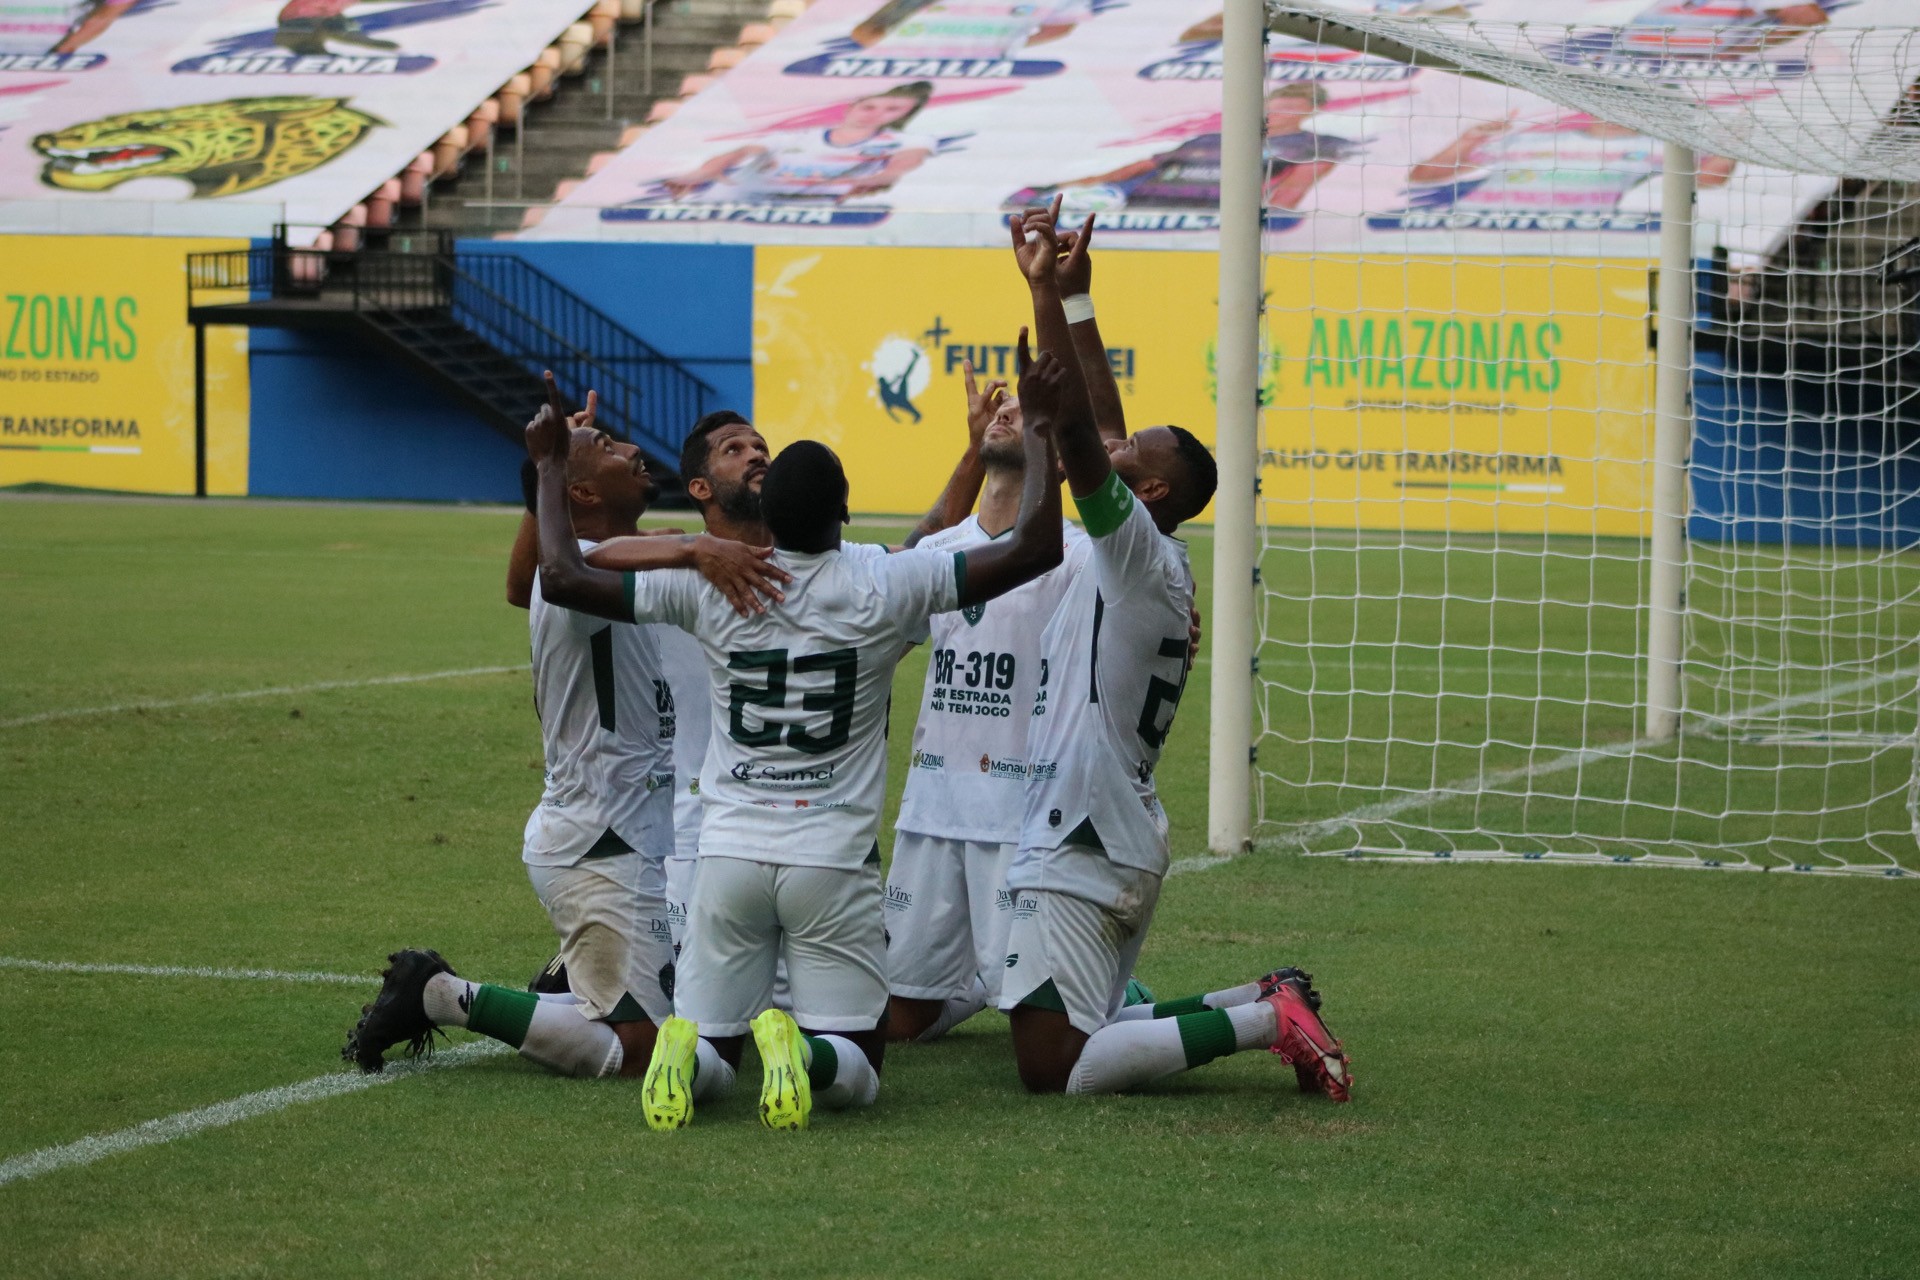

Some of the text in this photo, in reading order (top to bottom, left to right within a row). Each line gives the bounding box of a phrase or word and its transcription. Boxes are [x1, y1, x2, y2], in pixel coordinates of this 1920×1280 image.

[0, 54, 97, 71] IELE
[201, 55, 399, 75] MILENA
[823, 59, 1015, 78] NATALIA
[1150, 61, 1223, 80] MAR
[1056, 213, 1220, 230] CAMIL
[0, 294, 138, 362] ZONAS
[1304, 317, 1562, 393] AMAZONAS
[45, 371, 99, 383] ESTADO
[1336, 449, 1386, 471] QUE
[1395, 452, 1563, 476] TRANSFORMA
[934, 649, 1016, 690] BR-319
[728, 646, 858, 755] 23
[950, 689, 1011, 705] ESTRADA
[948, 703, 972, 714] TEM
[974, 706, 1010, 718] JOGO
[921, 752, 945, 768] AZONAS
[991, 760, 1027, 774] Manau
